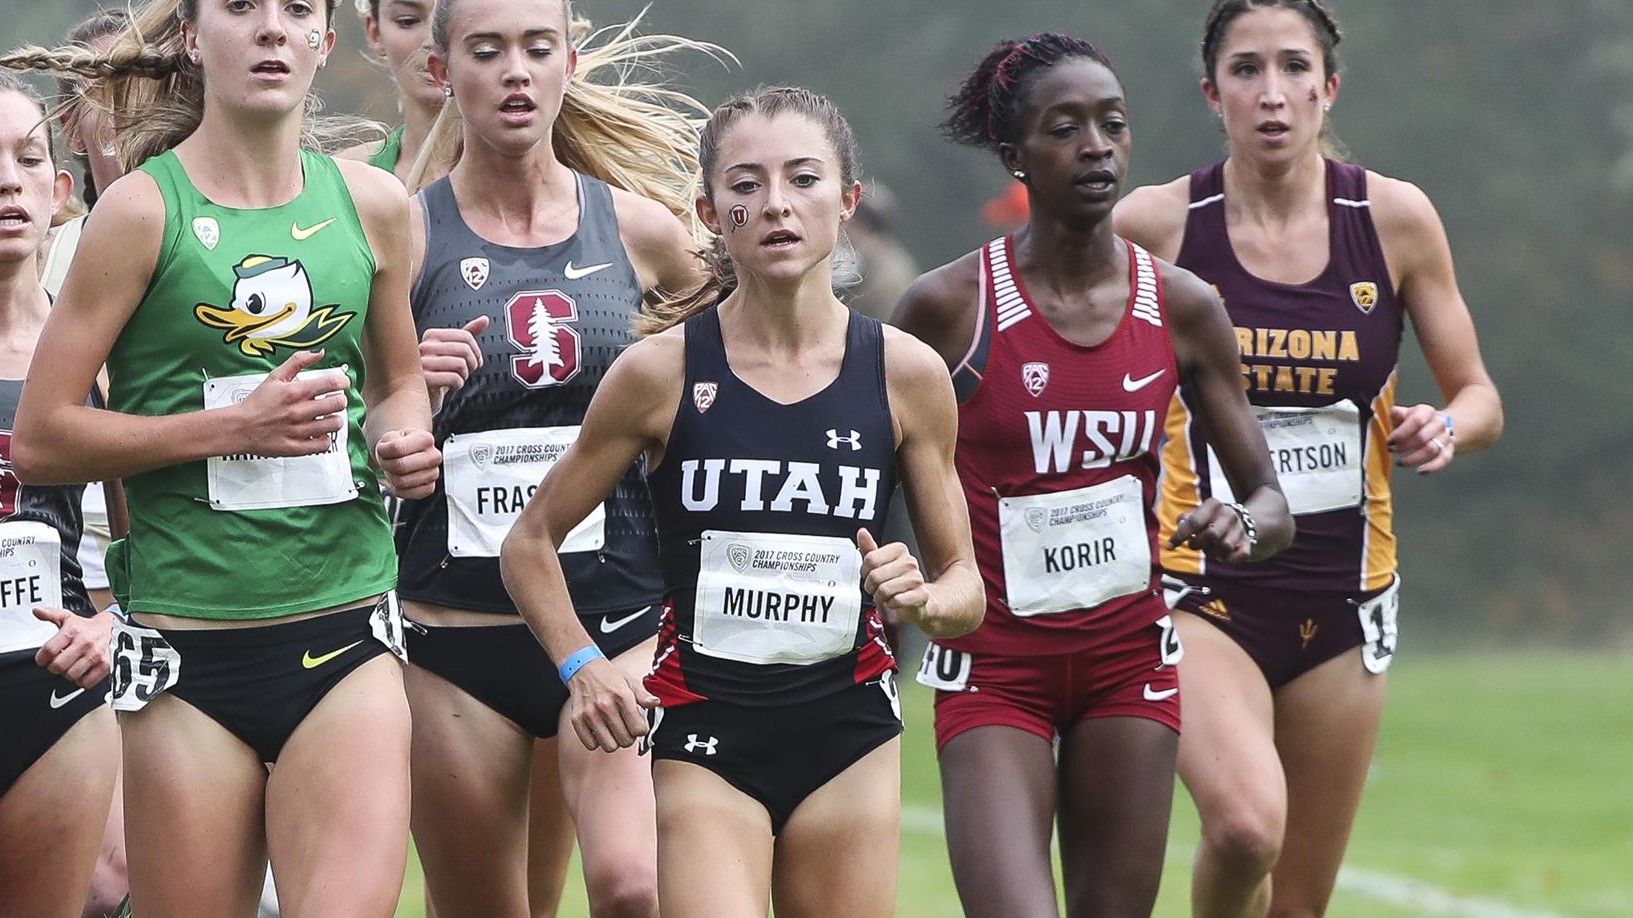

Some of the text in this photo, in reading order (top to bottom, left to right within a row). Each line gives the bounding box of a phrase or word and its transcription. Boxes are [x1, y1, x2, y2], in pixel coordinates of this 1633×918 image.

[1233, 326, 1360, 361] RIZONA
[693, 383, 718, 400] PAC
[697, 395, 710, 408] 12
[496, 446, 515, 455] 2017
[516, 444, 542, 454] CROSS
[1023, 410, 1156, 474] WSU
[1269, 442, 1347, 473] RTSON
[494, 453, 558, 464] CHAMPIONSHIPS
[681, 458, 880, 520] UTAH
[2, 536, 36, 548] COUNTRY
[754, 550, 774, 560] 2017
[776, 551, 804, 561] CROSS
[805, 553, 841, 564] COUNTRY
[1044, 537, 1116, 573] KORIR
[752, 559, 817, 572] CHAMPIONSHIPS
[0, 575, 42, 607] FFE
[723, 586, 835, 623] MURPHY
[113, 631, 171, 701] 65
